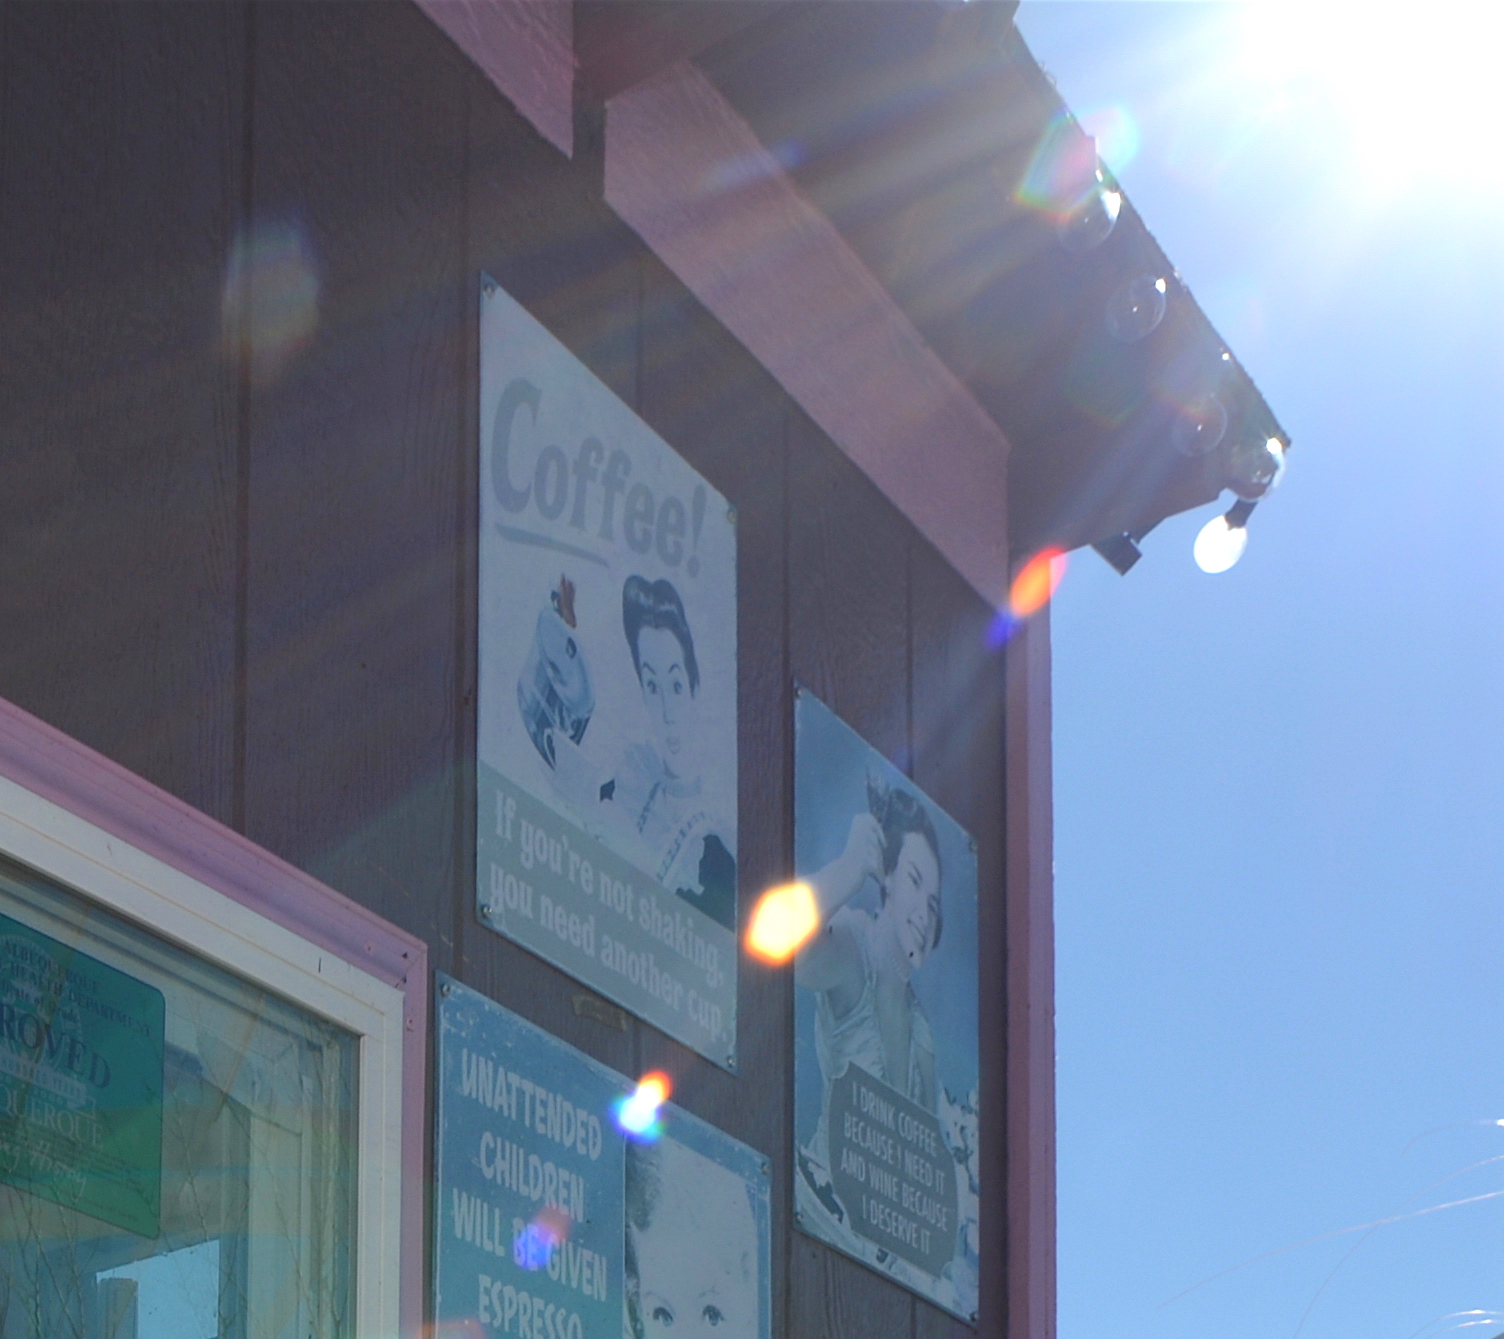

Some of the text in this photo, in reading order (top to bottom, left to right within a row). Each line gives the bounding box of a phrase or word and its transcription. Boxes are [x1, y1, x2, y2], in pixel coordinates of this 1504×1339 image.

[491, 377, 707, 579] Coffee!
[495, 790, 724, 989] If you're not shaking,
[491, 863, 728, 1042] you need another cup.
[461, 1048, 603, 1161] UNATTENDED
[844, 1111, 894, 1166] BECAUSE
[903, 1150, 933, 1188] NEED
[935, 1168, 945, 1196] IT
[860, 1086, 896, 1131] DRINK
[898, 1111, 937, 1158] COFFEE
[480, 1131, 585, 1224] CHILDREN
[840, 1147, 948, 1232] AND WINE BECAUSE
[870, 1199, 918, 1249] DESERVE
[920, 1228, 931, 1256] IT
[452, 1187, 607, 1302] WILL BE GIVEN
